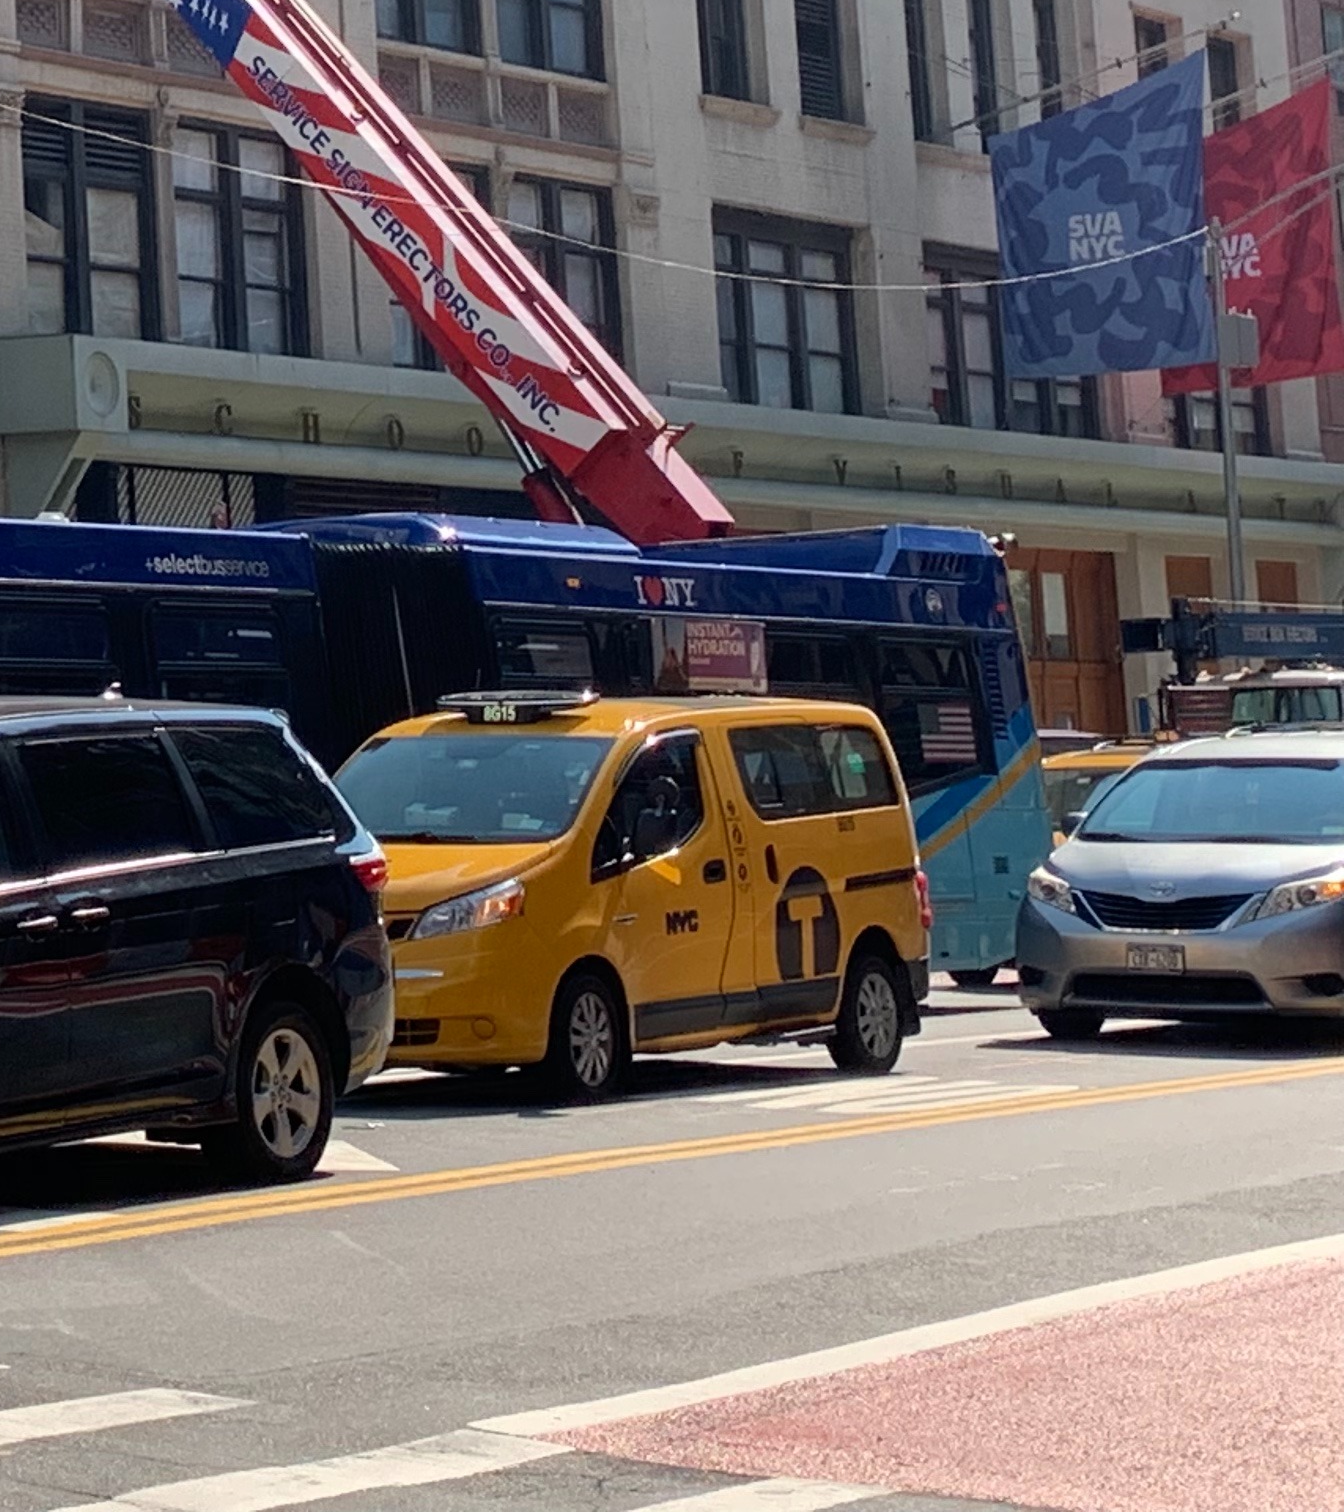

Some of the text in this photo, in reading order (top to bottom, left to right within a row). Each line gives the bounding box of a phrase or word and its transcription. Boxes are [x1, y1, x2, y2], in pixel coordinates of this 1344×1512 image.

[1068, 211, 1123, 237] SVA
[246, 55, 331, 155] SERVICE
[325, 147, 375, 210] SIGN
[371, 204, 481, 331] ERECTORS
[515, 373, 561, 433] INC.
[1068, 236, 1126, 261] NYC
[633, 575, 698, 607] I NY
[686, 621, 731, 638] INSTANT
[687, 638, 746, 657] HYDRATION
[665, 908, 700, 936] NYC
